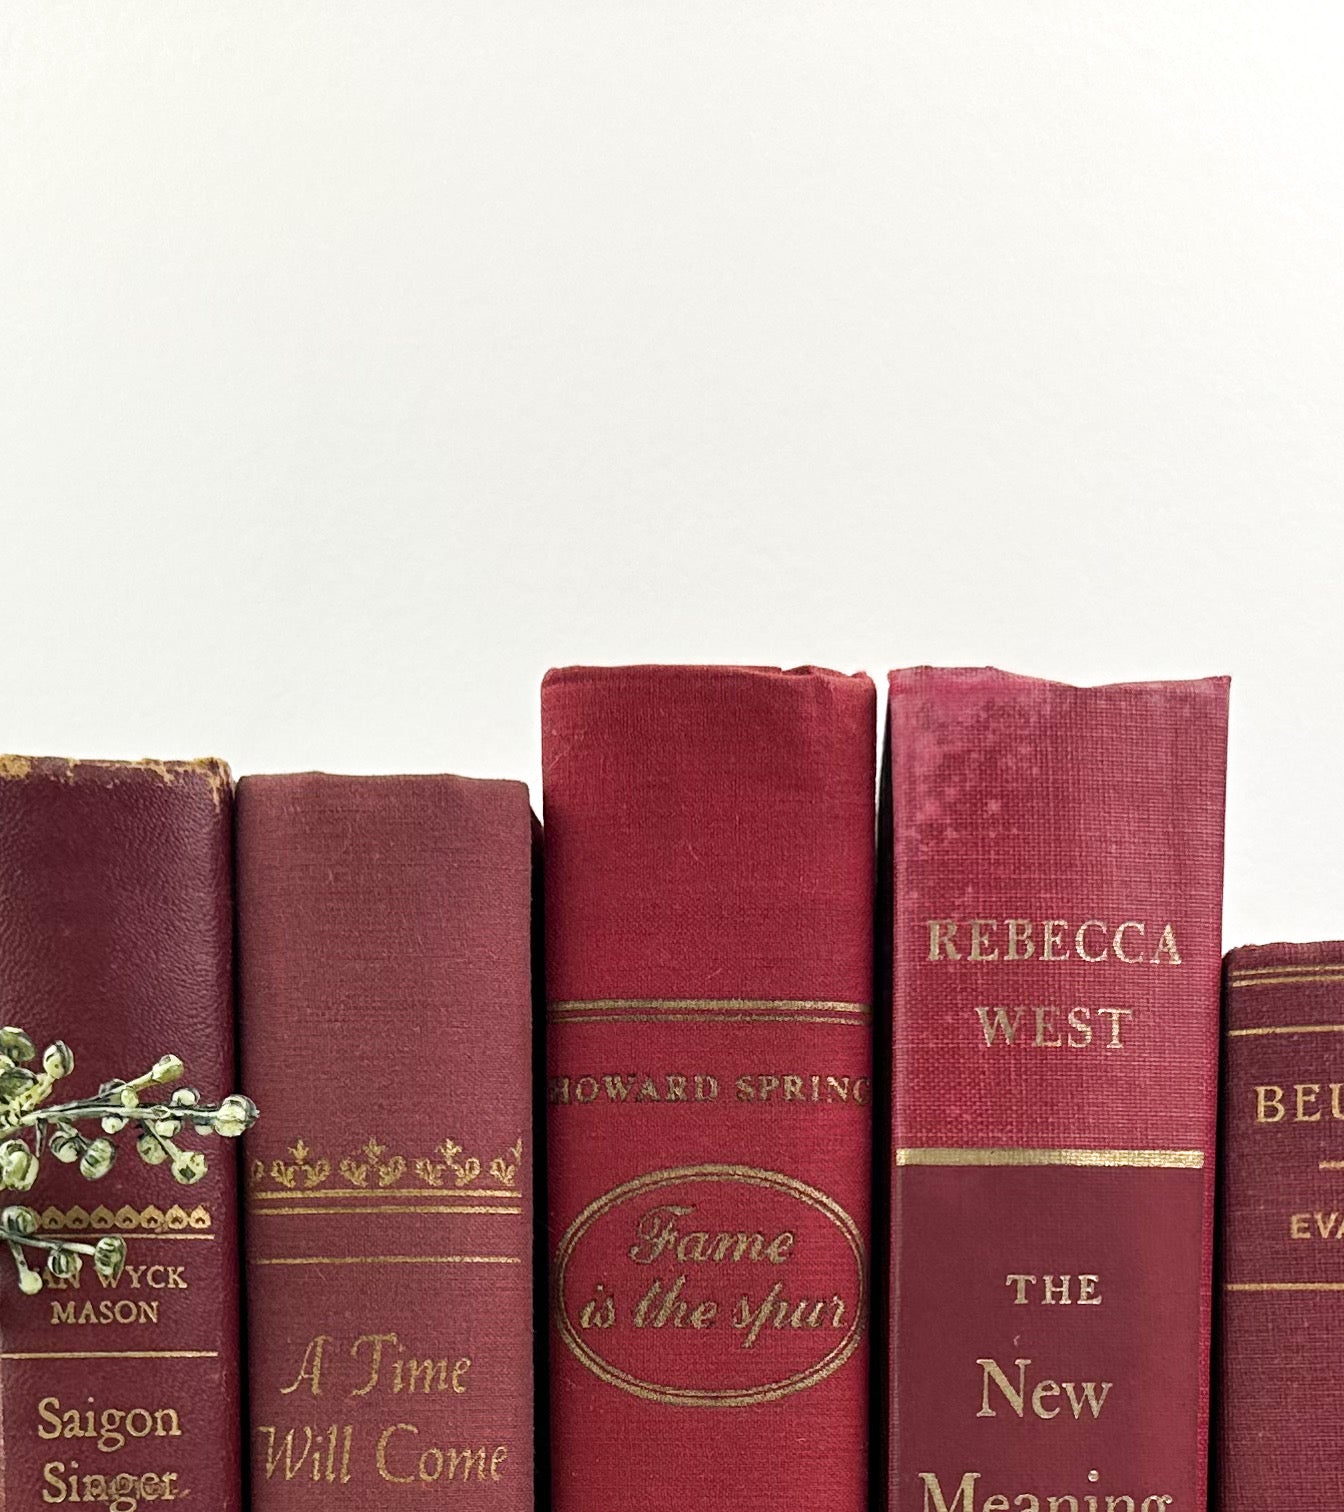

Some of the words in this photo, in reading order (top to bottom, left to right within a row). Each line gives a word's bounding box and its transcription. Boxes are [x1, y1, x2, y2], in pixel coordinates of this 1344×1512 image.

[927, 919, 1182, 965] REBECCA
[975, 1005, 1133, 1049] WEST
[549, 1073, 720, 1105] HOWARD
[628, 1203, 796, 1265] Fame
[29, 1264, 81, 1290] AN
[1005, 1274, 1103, 1305] THE
[50, 1299, 159, 1324] MASON
[578, 1282, 616, 1330] is
[632, 1274, 719, 1330] the
[732, 1281, 849, 1350] spur
[279, 1334, 333, 1396] A
[350, 1331, 472, 1397] Time
[975, 1358, 1114, 1420] New
[37, 1396, 183, 1453] Saigon
[257, 1423, 354, 1484] Will
[374, 1422, 508, 1484] Come
